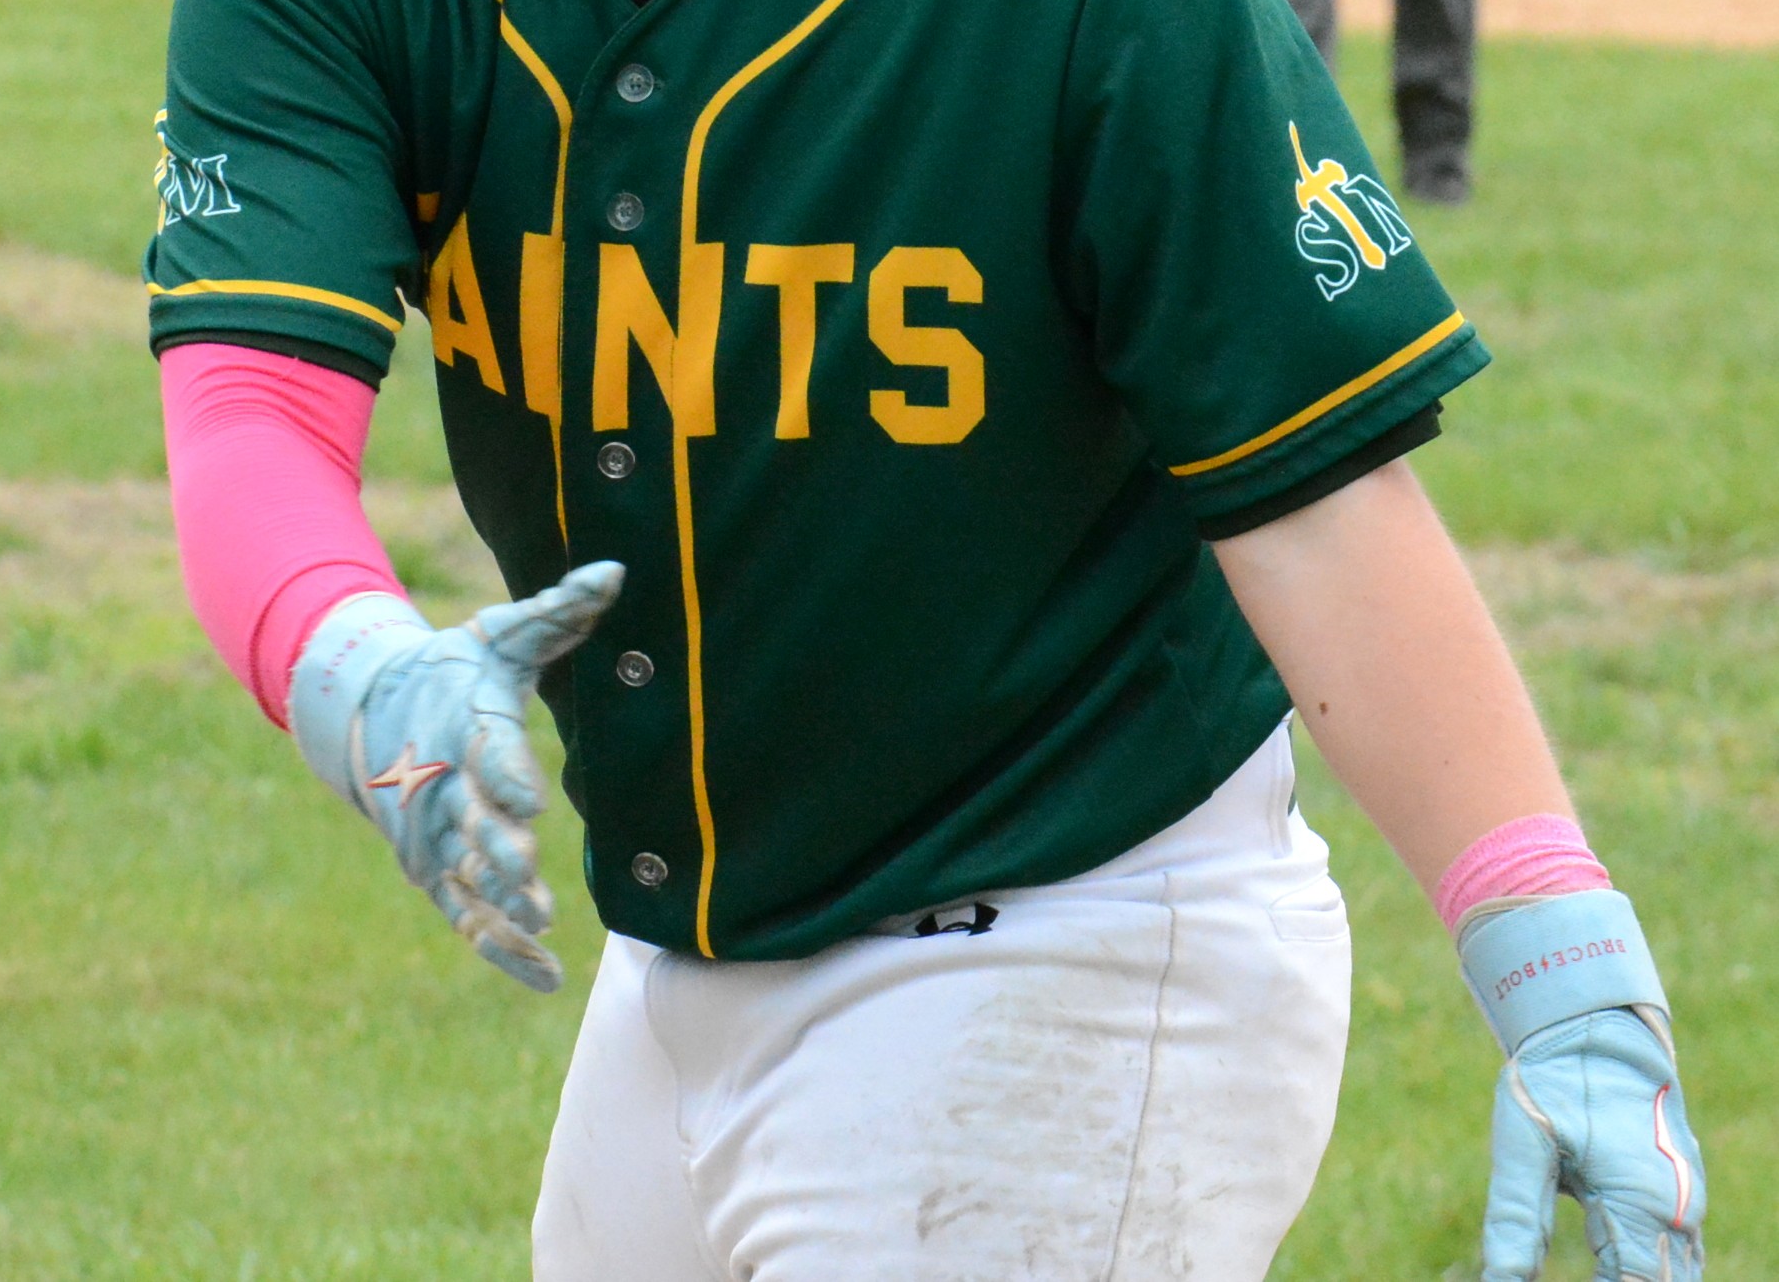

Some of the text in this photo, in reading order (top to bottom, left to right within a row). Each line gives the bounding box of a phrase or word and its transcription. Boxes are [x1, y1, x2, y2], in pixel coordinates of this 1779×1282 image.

[417, 192, 986, 445] AINTS
[1494, 938, 1627, 1001] BRUCE BOLT
